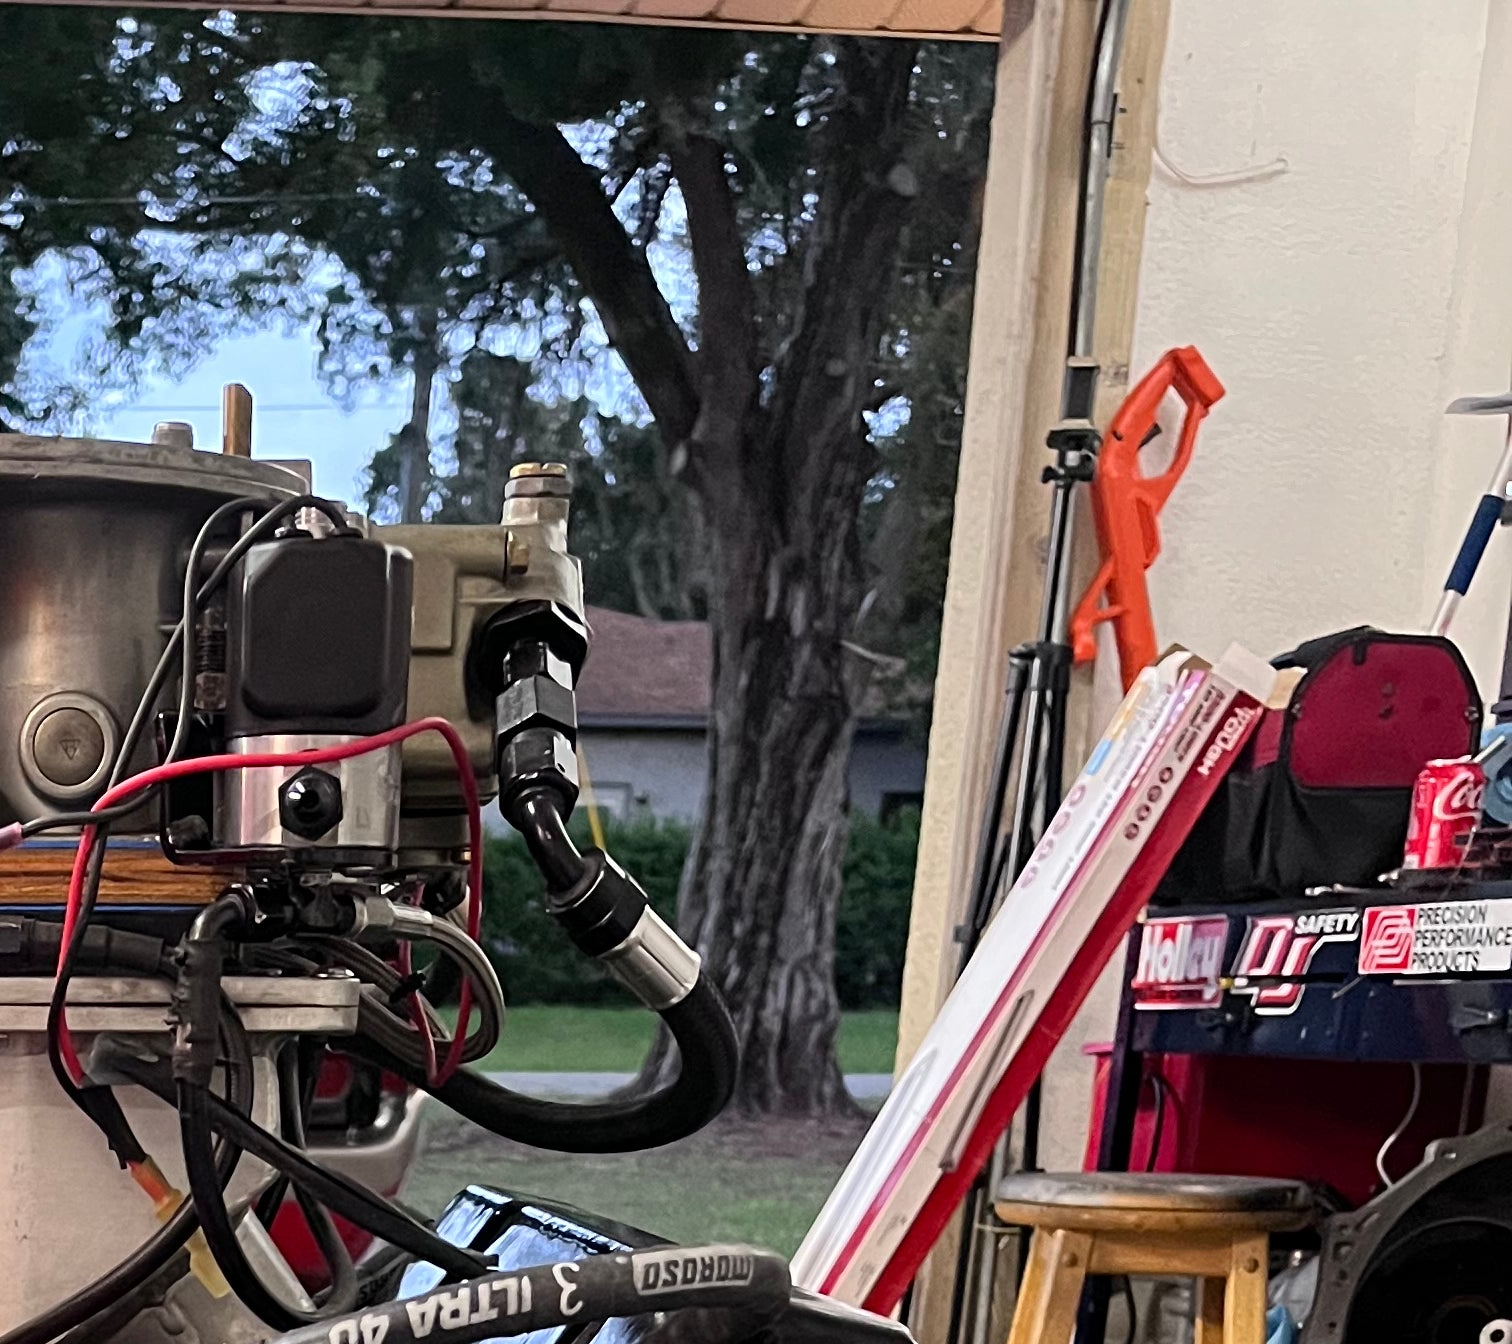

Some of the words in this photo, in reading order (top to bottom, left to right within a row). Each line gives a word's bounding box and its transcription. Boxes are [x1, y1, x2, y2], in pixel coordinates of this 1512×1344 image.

[1295, 912, 1360, 935] SAFETY
[1418, 905, 1488, 925] PRECISION
[1415, 926, 1512, 947] PERFORMANCE
[1136, 923, 1221, 1000] Holley
[1411, 950, 1480, 971] PRODUCTS
[641, 1253, 754, 1291] MOROSO
